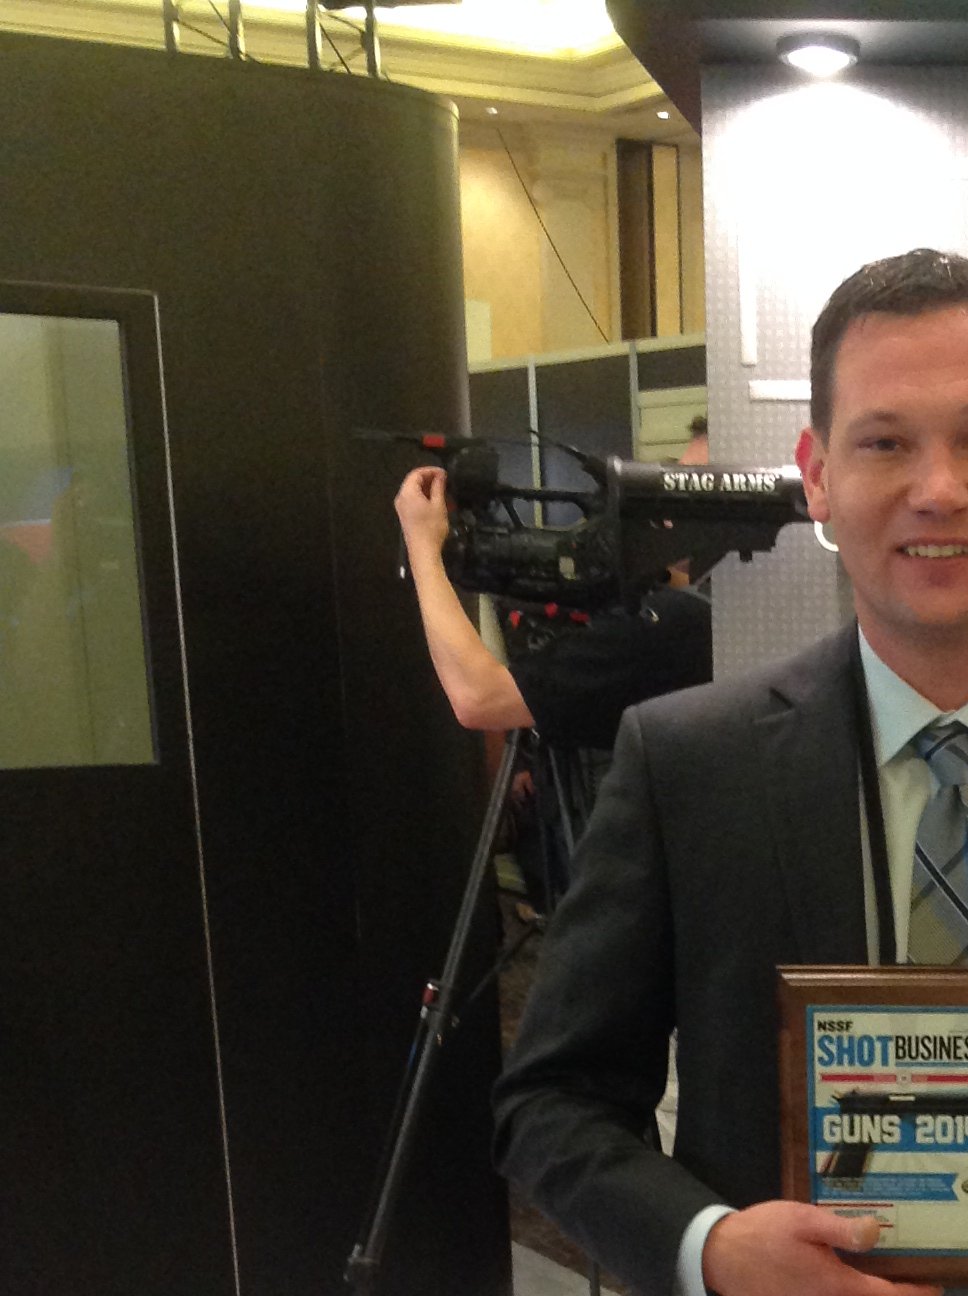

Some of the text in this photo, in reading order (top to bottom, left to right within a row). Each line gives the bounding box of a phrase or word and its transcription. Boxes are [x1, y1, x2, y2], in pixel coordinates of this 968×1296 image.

[663, 472, 776, 492] STAG ARMS
[818, 1020, 853, 1032] NSSF
[823, 1114, 901, 1144] GUNS
